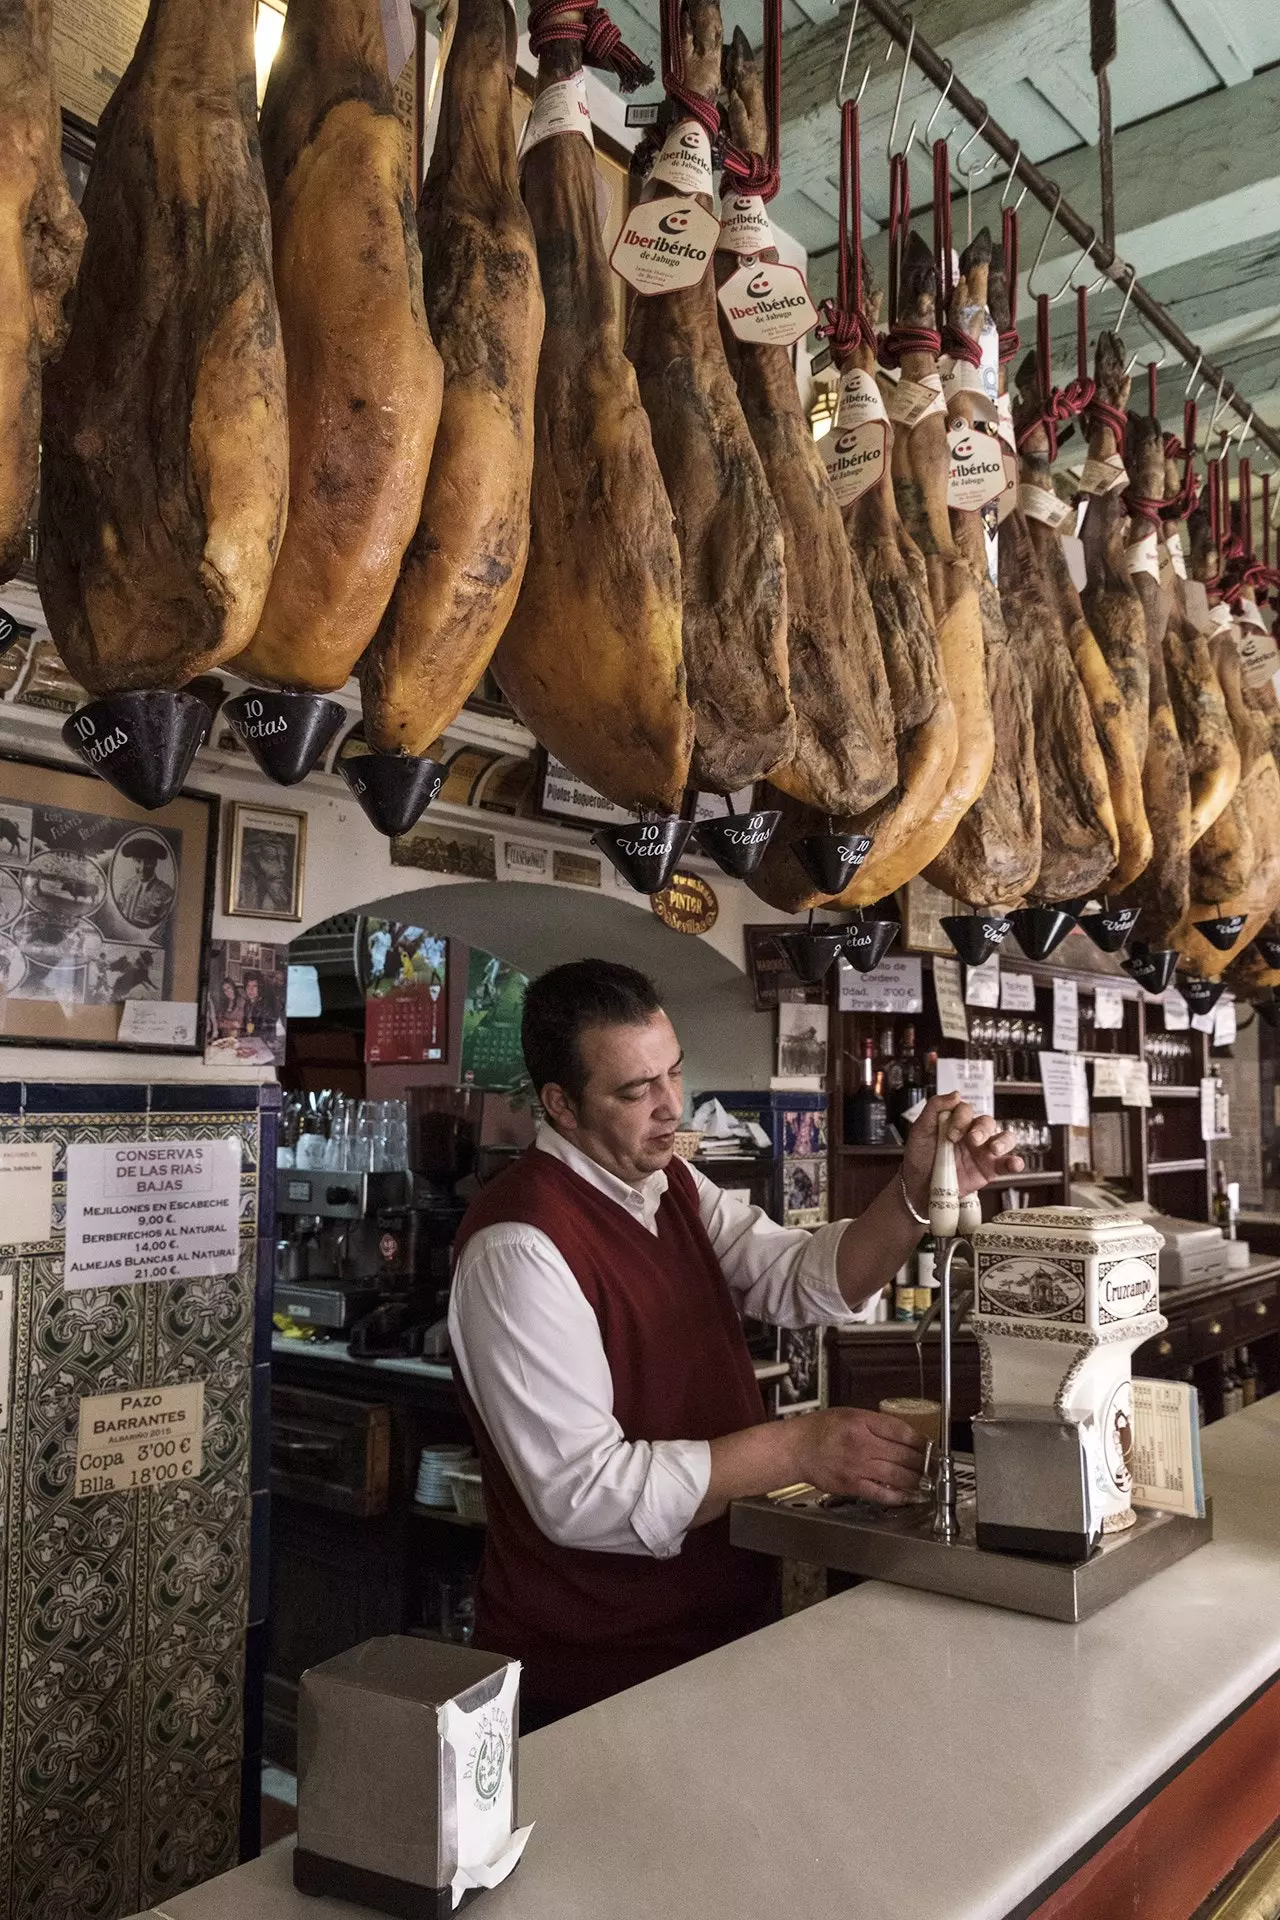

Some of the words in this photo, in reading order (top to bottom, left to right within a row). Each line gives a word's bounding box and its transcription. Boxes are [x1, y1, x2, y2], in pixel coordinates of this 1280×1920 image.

[623, 230, 707, 261] Iberibérico
[640, 250, 650, 259] de
[650, 252, 681, 268] Jabugo
[729, 294, 807, 321] Iberibérico
[755, 314, 765, 324] de
[766, 310, 792, 323] Jabugo
[244, 699, 264, 719] 10
[73, 716, 96, 742] 10
[233, 716, 288, 739] Vetas
[747, 816, 764, 831] 10
[639, 825, 659, 841] 10
[724, 829, 771, 845] Vetas
[616, 838, 673, 857] Vetas
[856, 840, 870, 852] 10
[1119, 911, 1132, 922] 10
[846, 926, 859, 937] 10
[998, 922, 1011, 933] 10
[847, 933, 873, 948] etas
[860, 974, 900, 983] Cordero
[115, 1147, 204, 1162] CONSERVAS
[116, 1166, 137, 1178] DE
[140, 1165, 167, 1177] LAS
[170, 1163, 204, 1175] RIAS
[137, 1179, 183, 1193] BAJAS
[83, 1204, 150, 1217] MEJILLONES
[152, 1202, 167, 1212] EN
[169, 1198, 230, 1210] ESCABECHE
[82, 1230, 162, 1244] BERBERECHOS
[164, 1228, 178, 1237] AL
[180, 1224, 228, 1236] NATURAL
[69, 1259, 122, 1273] ALMEJAS
[124, 1253, 175, 1267] BLANCAS
[176, 1252, 190, 1262] AL
[1104, 1278, 1152, 1304] Cruzcampo
[120, 1394, 163, 1411] PAZO
[93, 1410, 187, 1434] BARRANTES
[79, 1452, 125, 1473] Copa
[179, 1437, 192, 1454] €
[79, 1475, 115, 1496] Blla
[182, 1459, 194, 1476] €
